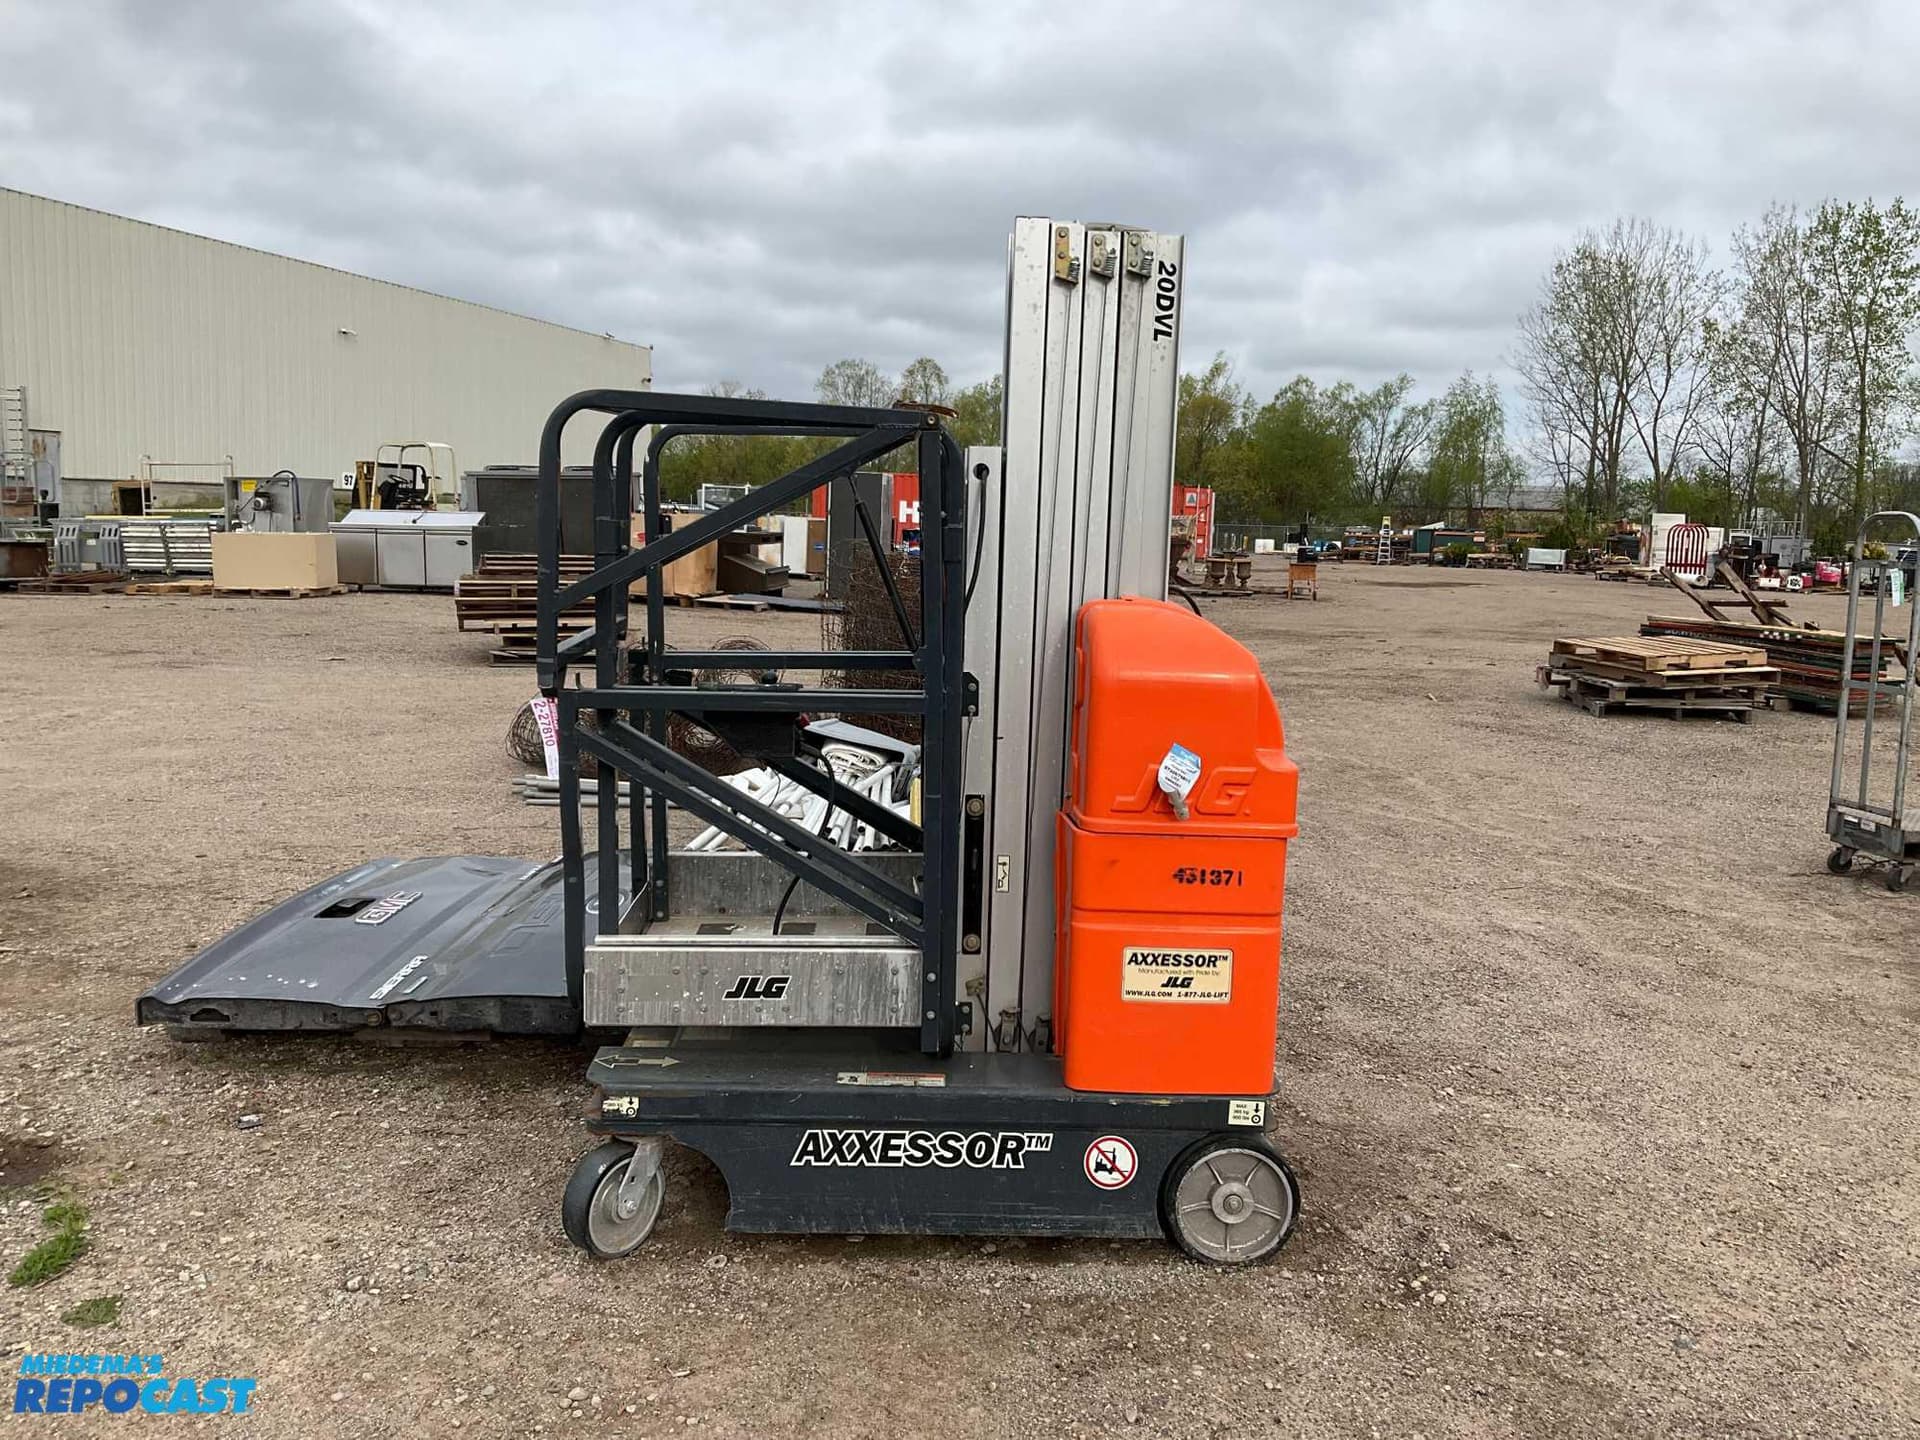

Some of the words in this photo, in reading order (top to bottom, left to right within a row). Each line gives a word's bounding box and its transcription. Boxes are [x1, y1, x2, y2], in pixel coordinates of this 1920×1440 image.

[1153, 260, 1177, 342] 20DVL
[343, 474, 353, 486] 97
[355, 890, 423, 924] GMC
[722, 975, 792, 1000] JLG
[1160, 976, 1194, 988] JLG
